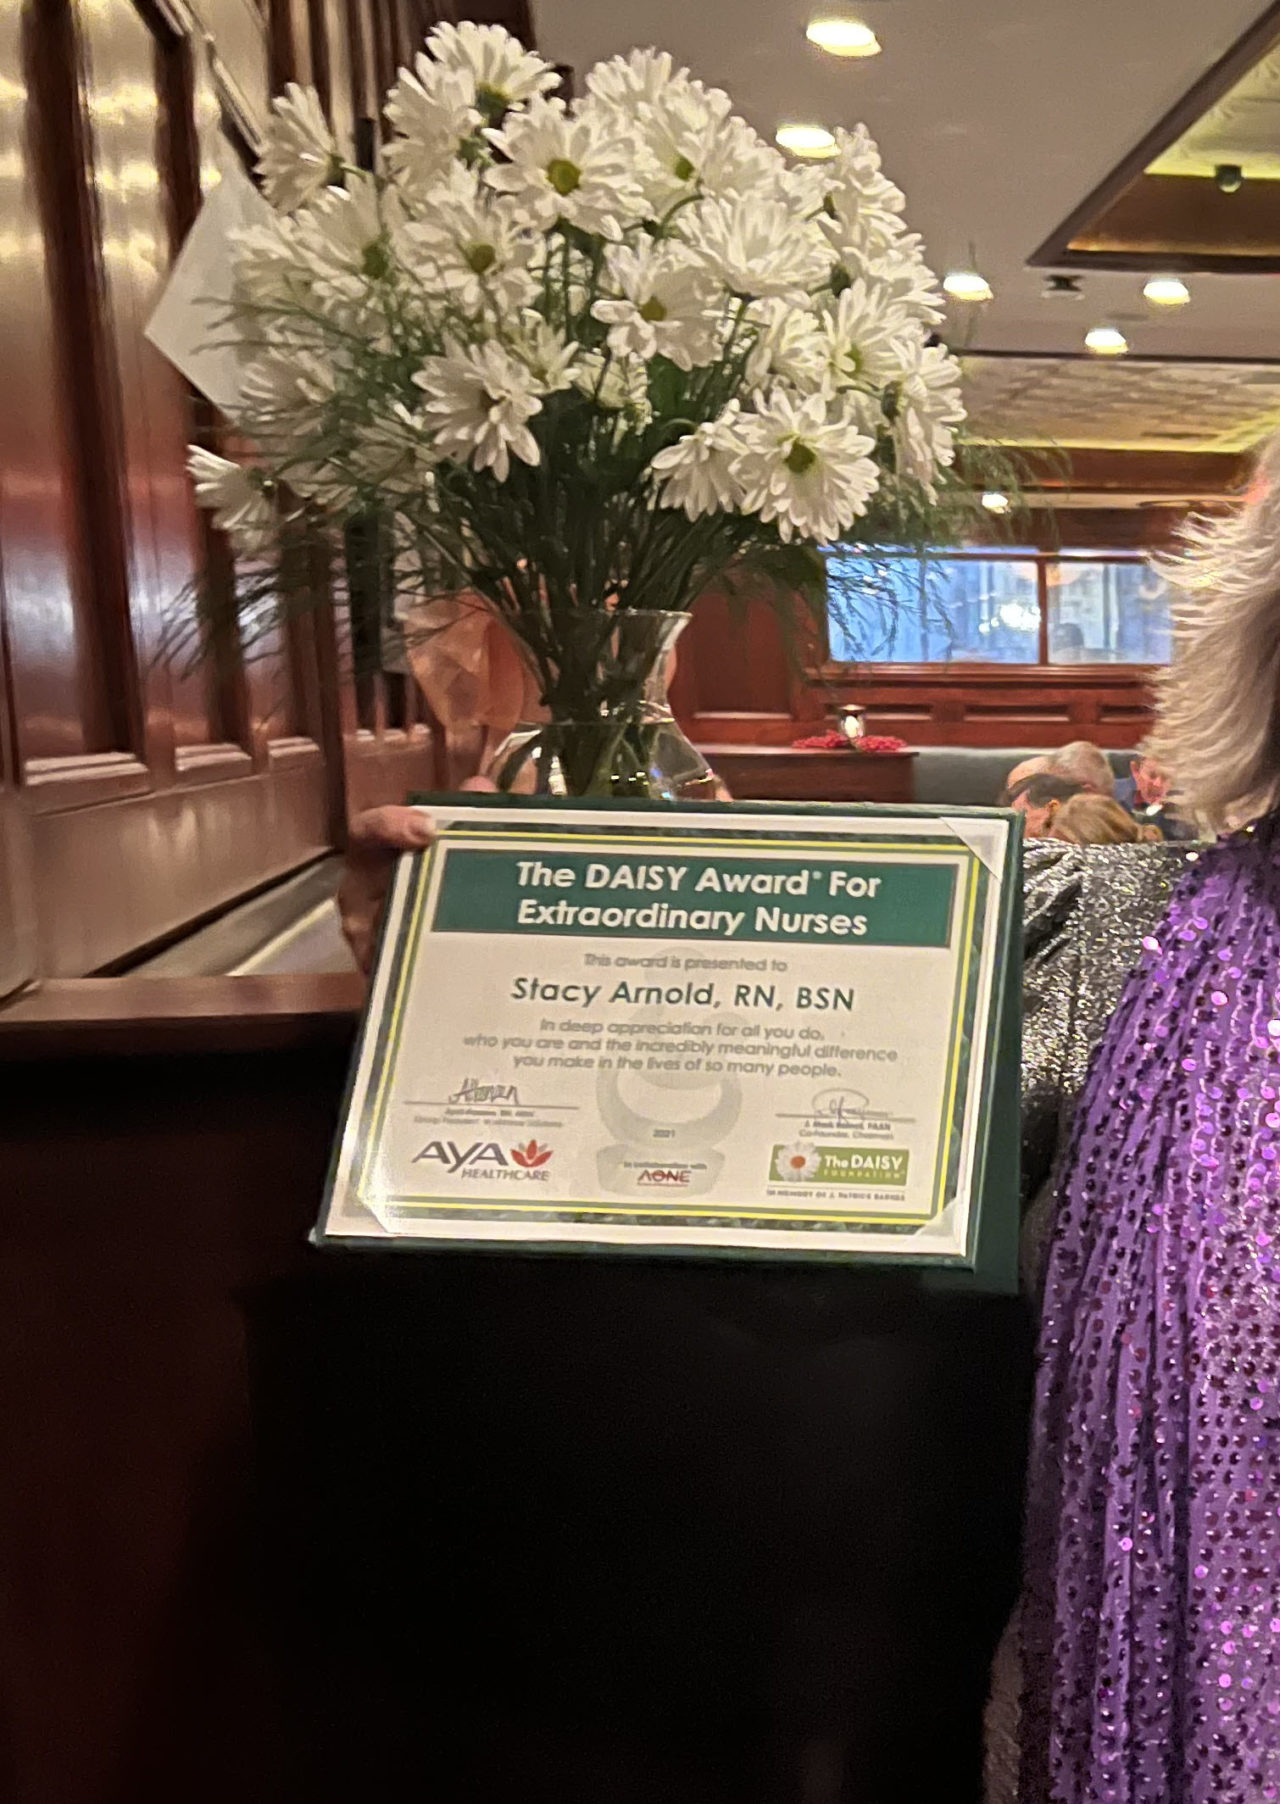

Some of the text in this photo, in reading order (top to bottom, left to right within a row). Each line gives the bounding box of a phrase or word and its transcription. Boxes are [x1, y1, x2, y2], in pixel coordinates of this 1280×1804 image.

[516, 861, 576, 888] The
[585, 863, 688, 891] DAISY
[829, 870, 881, 898] For
[517, 899, 867, 936] Extraordinary Nurses
[614, 955, 668, 970] award
[671, 955, 681, 969] is
[684, 957, 767, 972] presented
[771, 959, 788, 972] to
[511, 977, 854, 1011] Stacy Arnold, RN, BSN
[539, 1018, 555, 1031] In
[559, 1019, 603, 1035] deep
[607, 1021, 711, 1036] appreciation
[716, 1023, 737, 1036] for
[741, 1024, 760, 1037] all
[764, 1026, 794, 1040] you
[463, 1034, 898, 1062] who you are and the incredibly meaningful difference
[513, 1054, 842, 1078] you make in the lives of so many people.
[411, 1141, 509, 1174] AYA
[824, 1154, 903, 1170] The DAISY
[461, 1167, 550, 1182] HEALTHCARE
